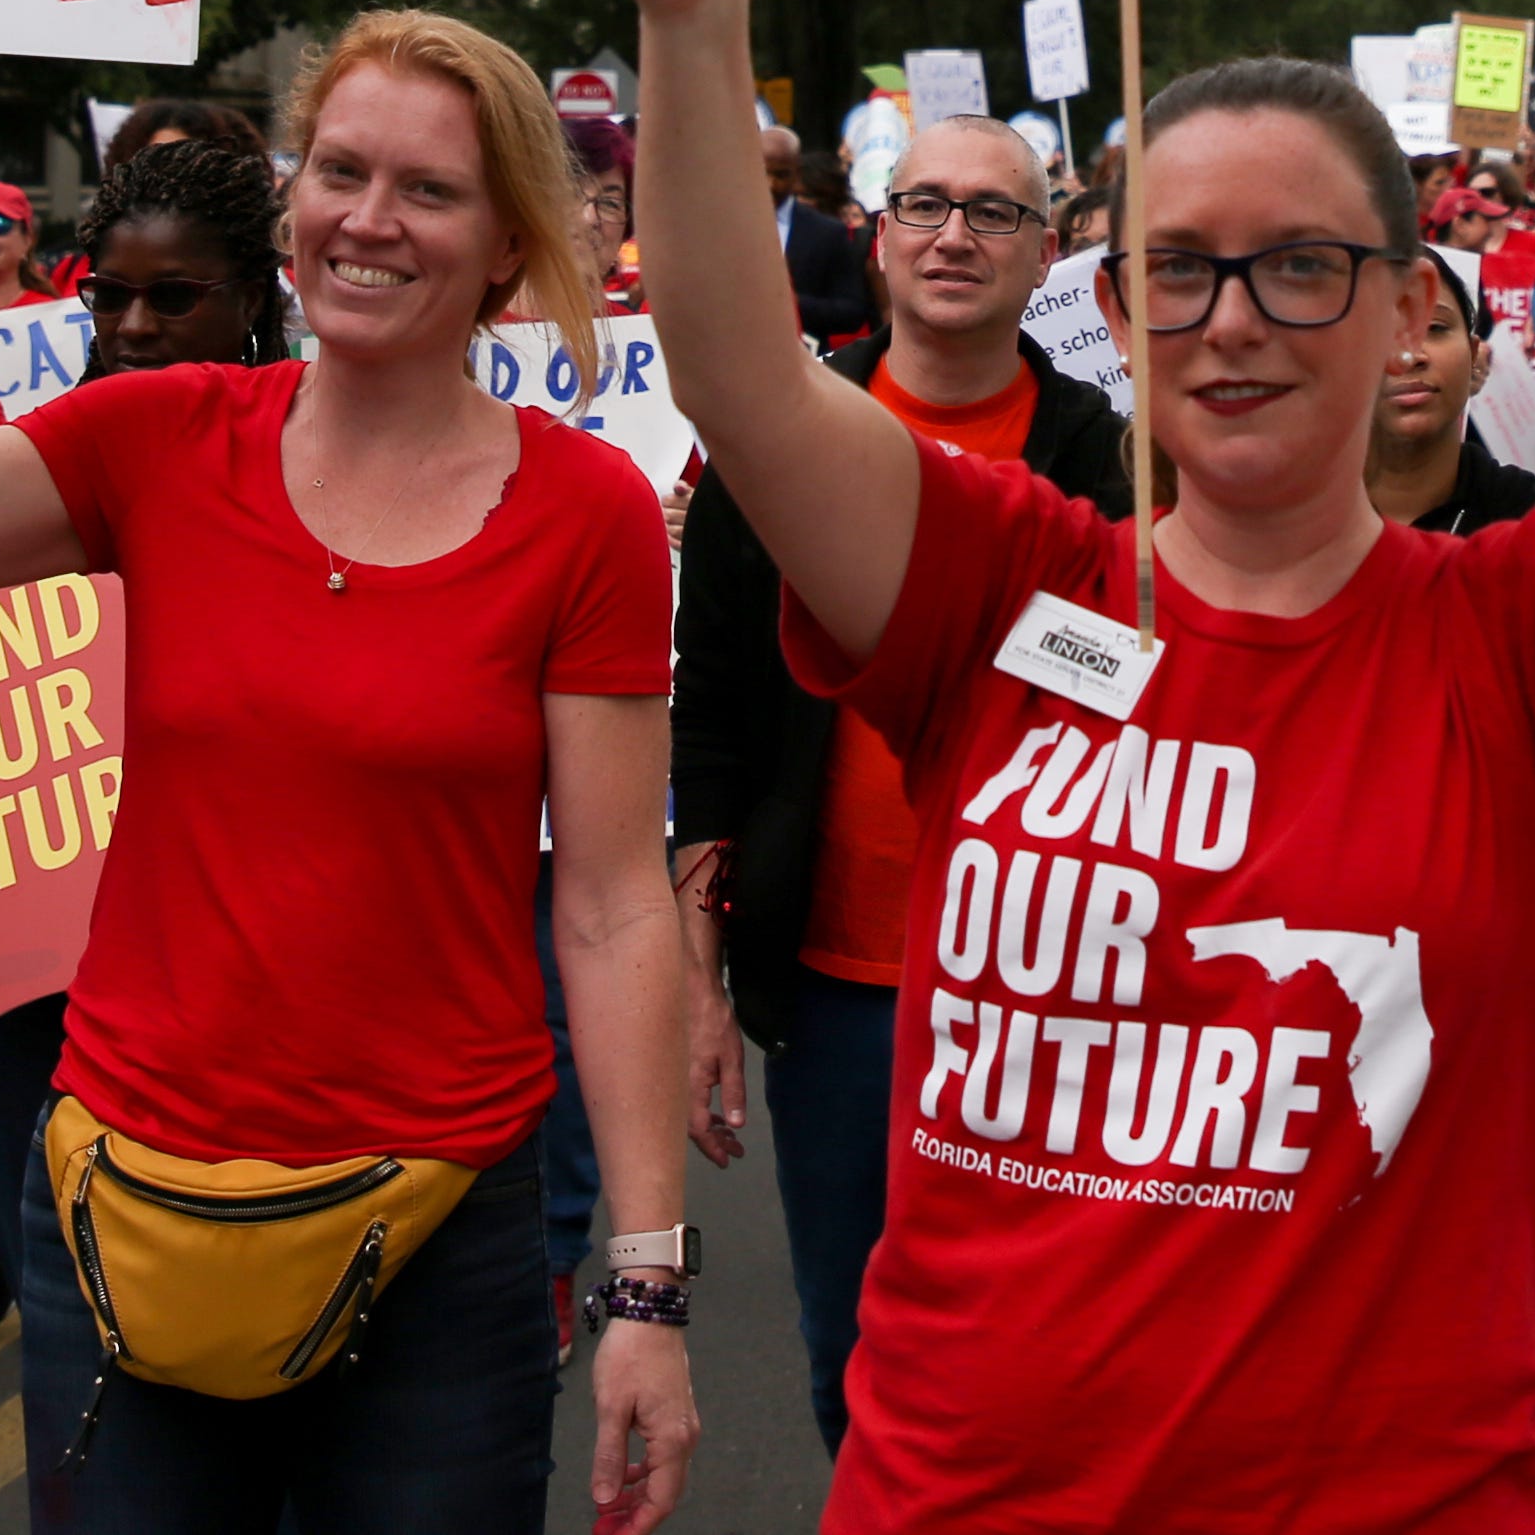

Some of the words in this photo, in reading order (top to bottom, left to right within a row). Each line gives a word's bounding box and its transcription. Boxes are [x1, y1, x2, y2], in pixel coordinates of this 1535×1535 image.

[1021, 287, 1089, 322] acher-
[1061, 326, 1109, 355] scho
[1043, 634, 1117, 676] LINTON
[962, 721, 1257, 872] FUND
[937, 839, 1160, 1006] OUR
[920, 987, 1331, 1174] FUTURE
[912, 1127, 992, 1176] FLORIDA
[998, 1158, 1130, 1201] EDUCATION
[1126, 1178, 1295, 1213] ASSOCIATION
